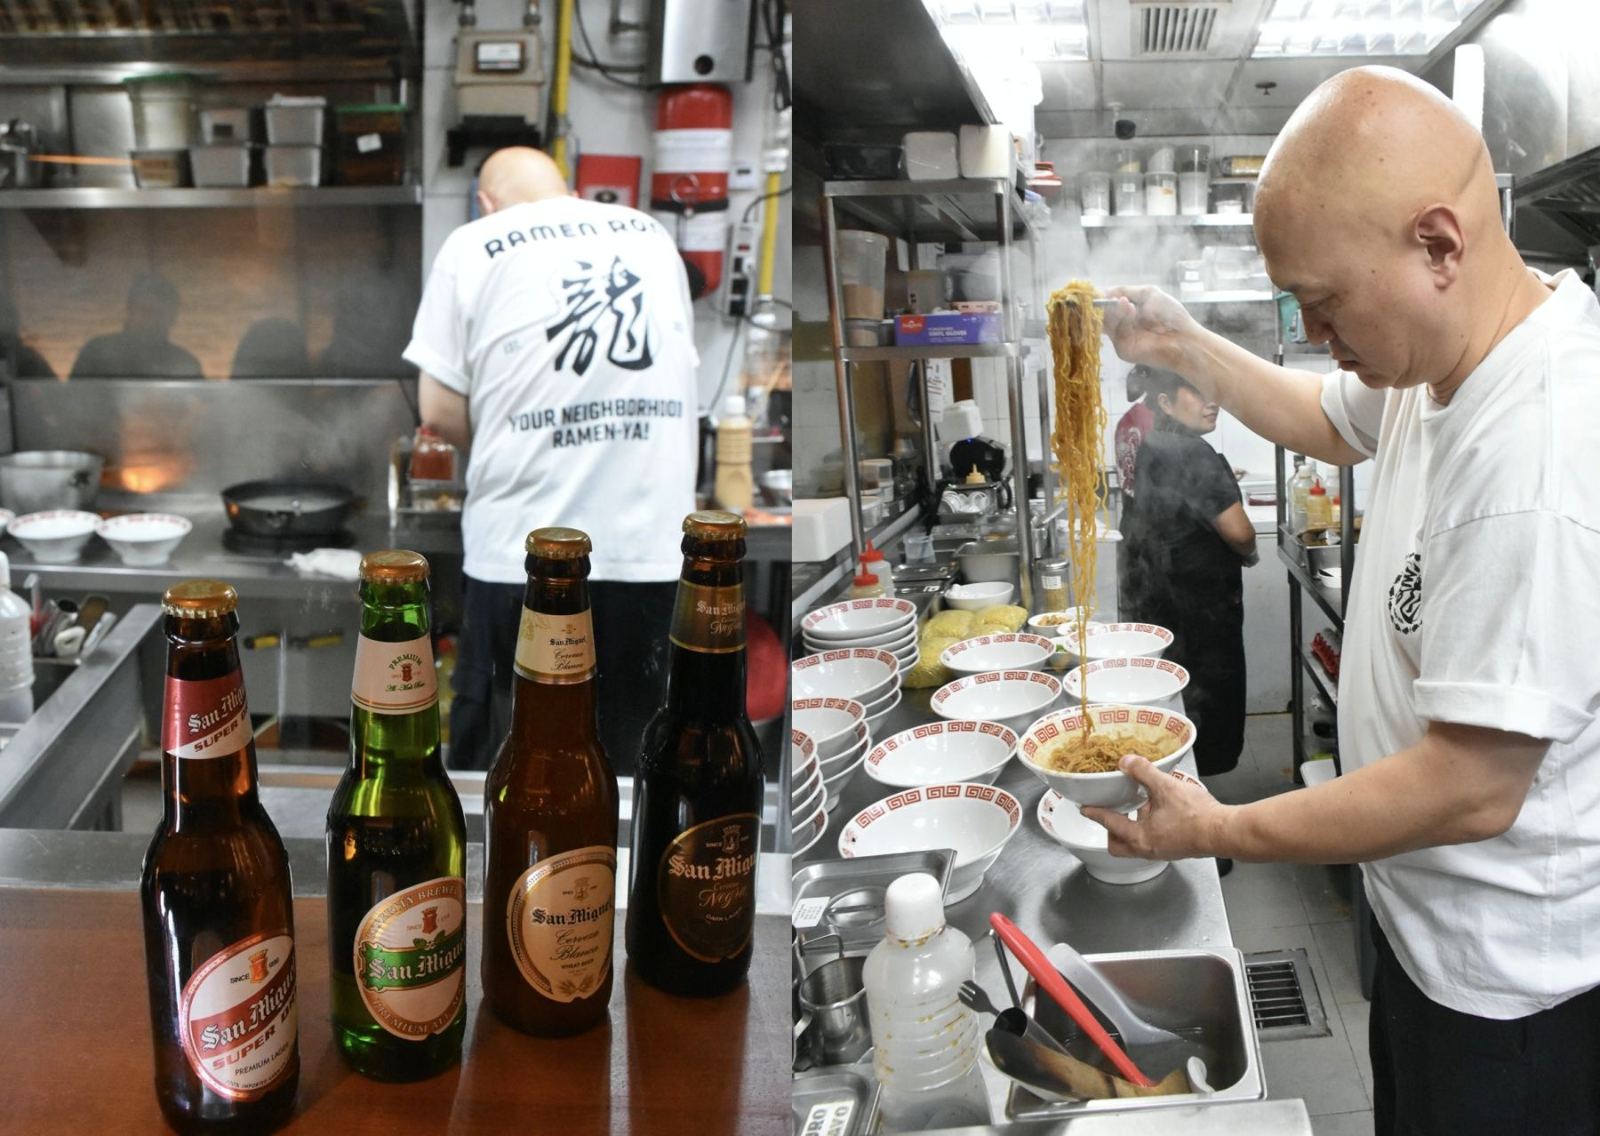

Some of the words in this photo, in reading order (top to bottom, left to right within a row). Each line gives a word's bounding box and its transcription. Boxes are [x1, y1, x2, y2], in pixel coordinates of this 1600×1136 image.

[484, 222, 598, 259] RAMEN
[546, 255, 654, 377] 龍
[508, 408, 556, 433] YOUR
[552, 422, 650, 449] RAMEN-YA!
[696, 600, 720, 617] San
[388, 653, 423, 670] PREMIUM
[188, 709, 221, 733] San
[194, 721, 240, 752] SUPER
[668, 854, 711, 880] San
[532, 908, 565, 925] San
[229, 974, 250, 984] SINCE
[368, 958, 413, 980] San
[200, 1019, 247, 1051] San
[212, 1026, 277, 1070] SUPER
[235, 1057, 270, 1076] PREMIUM
